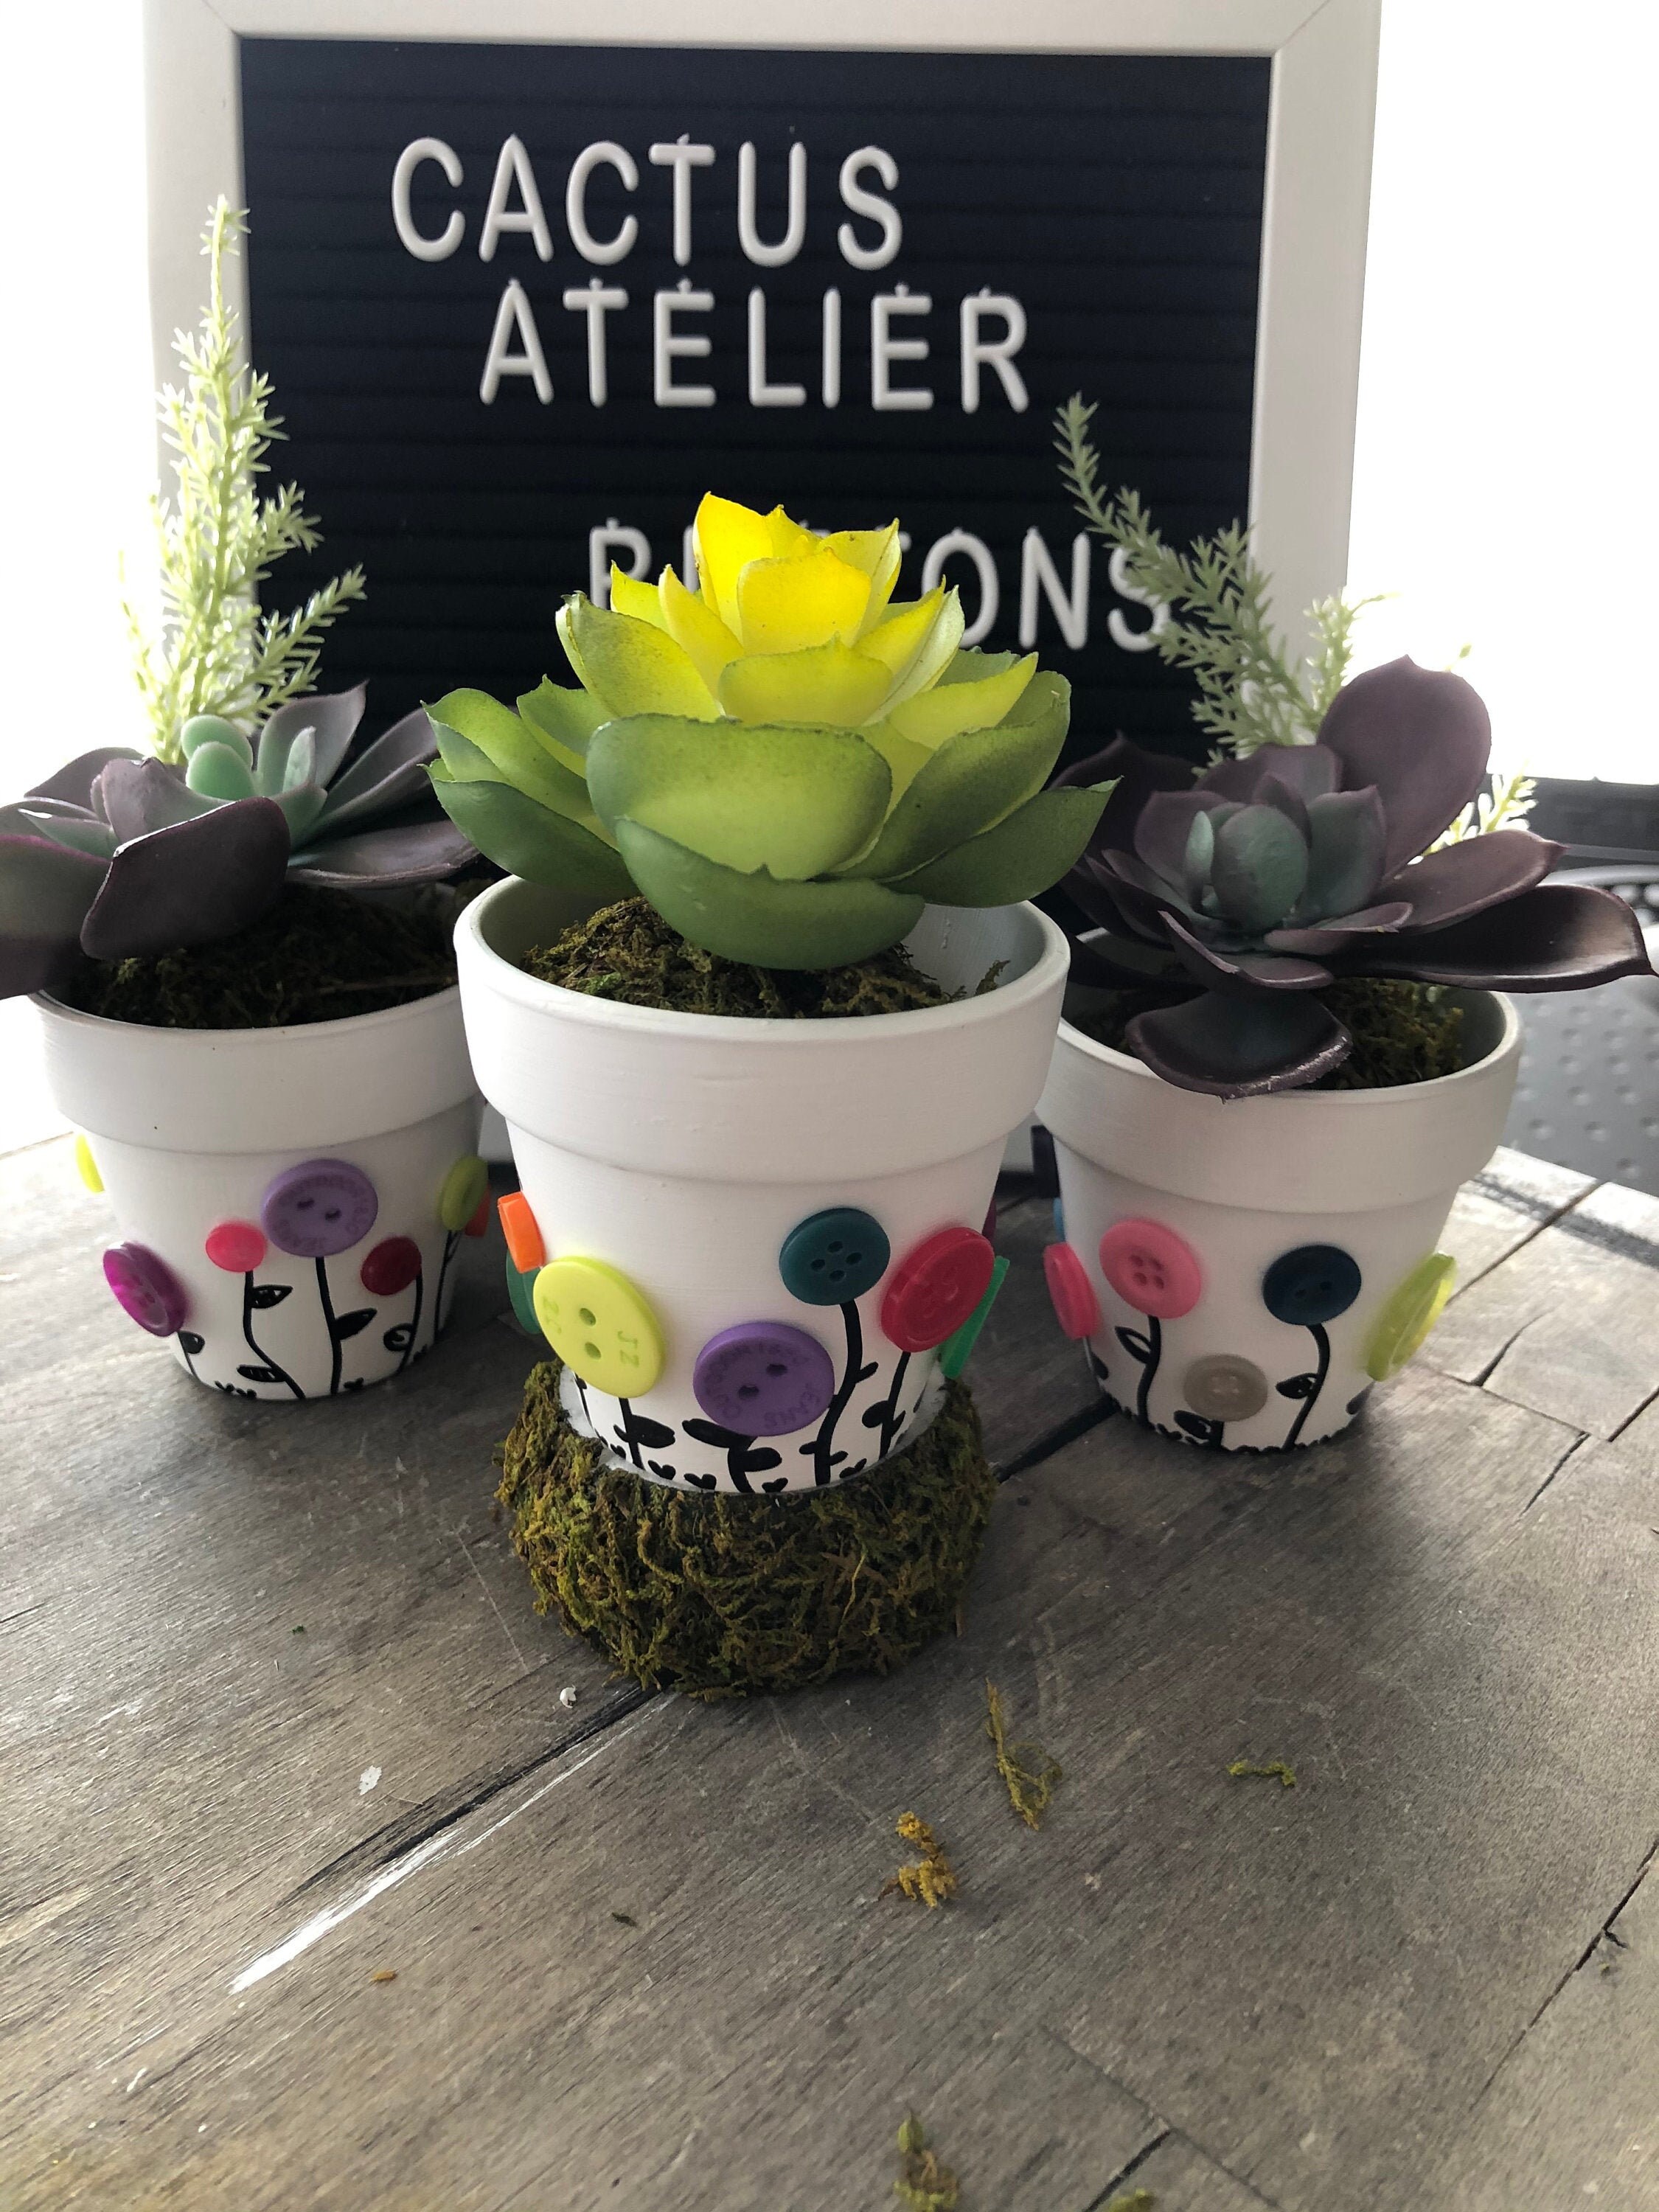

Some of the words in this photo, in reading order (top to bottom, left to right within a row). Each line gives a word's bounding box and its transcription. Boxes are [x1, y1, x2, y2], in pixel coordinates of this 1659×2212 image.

[392, 134, 903, 271] CACTUS
[479, 279, 1029, 414] ATELIER
[590, 518, 1172, 652] BONS
